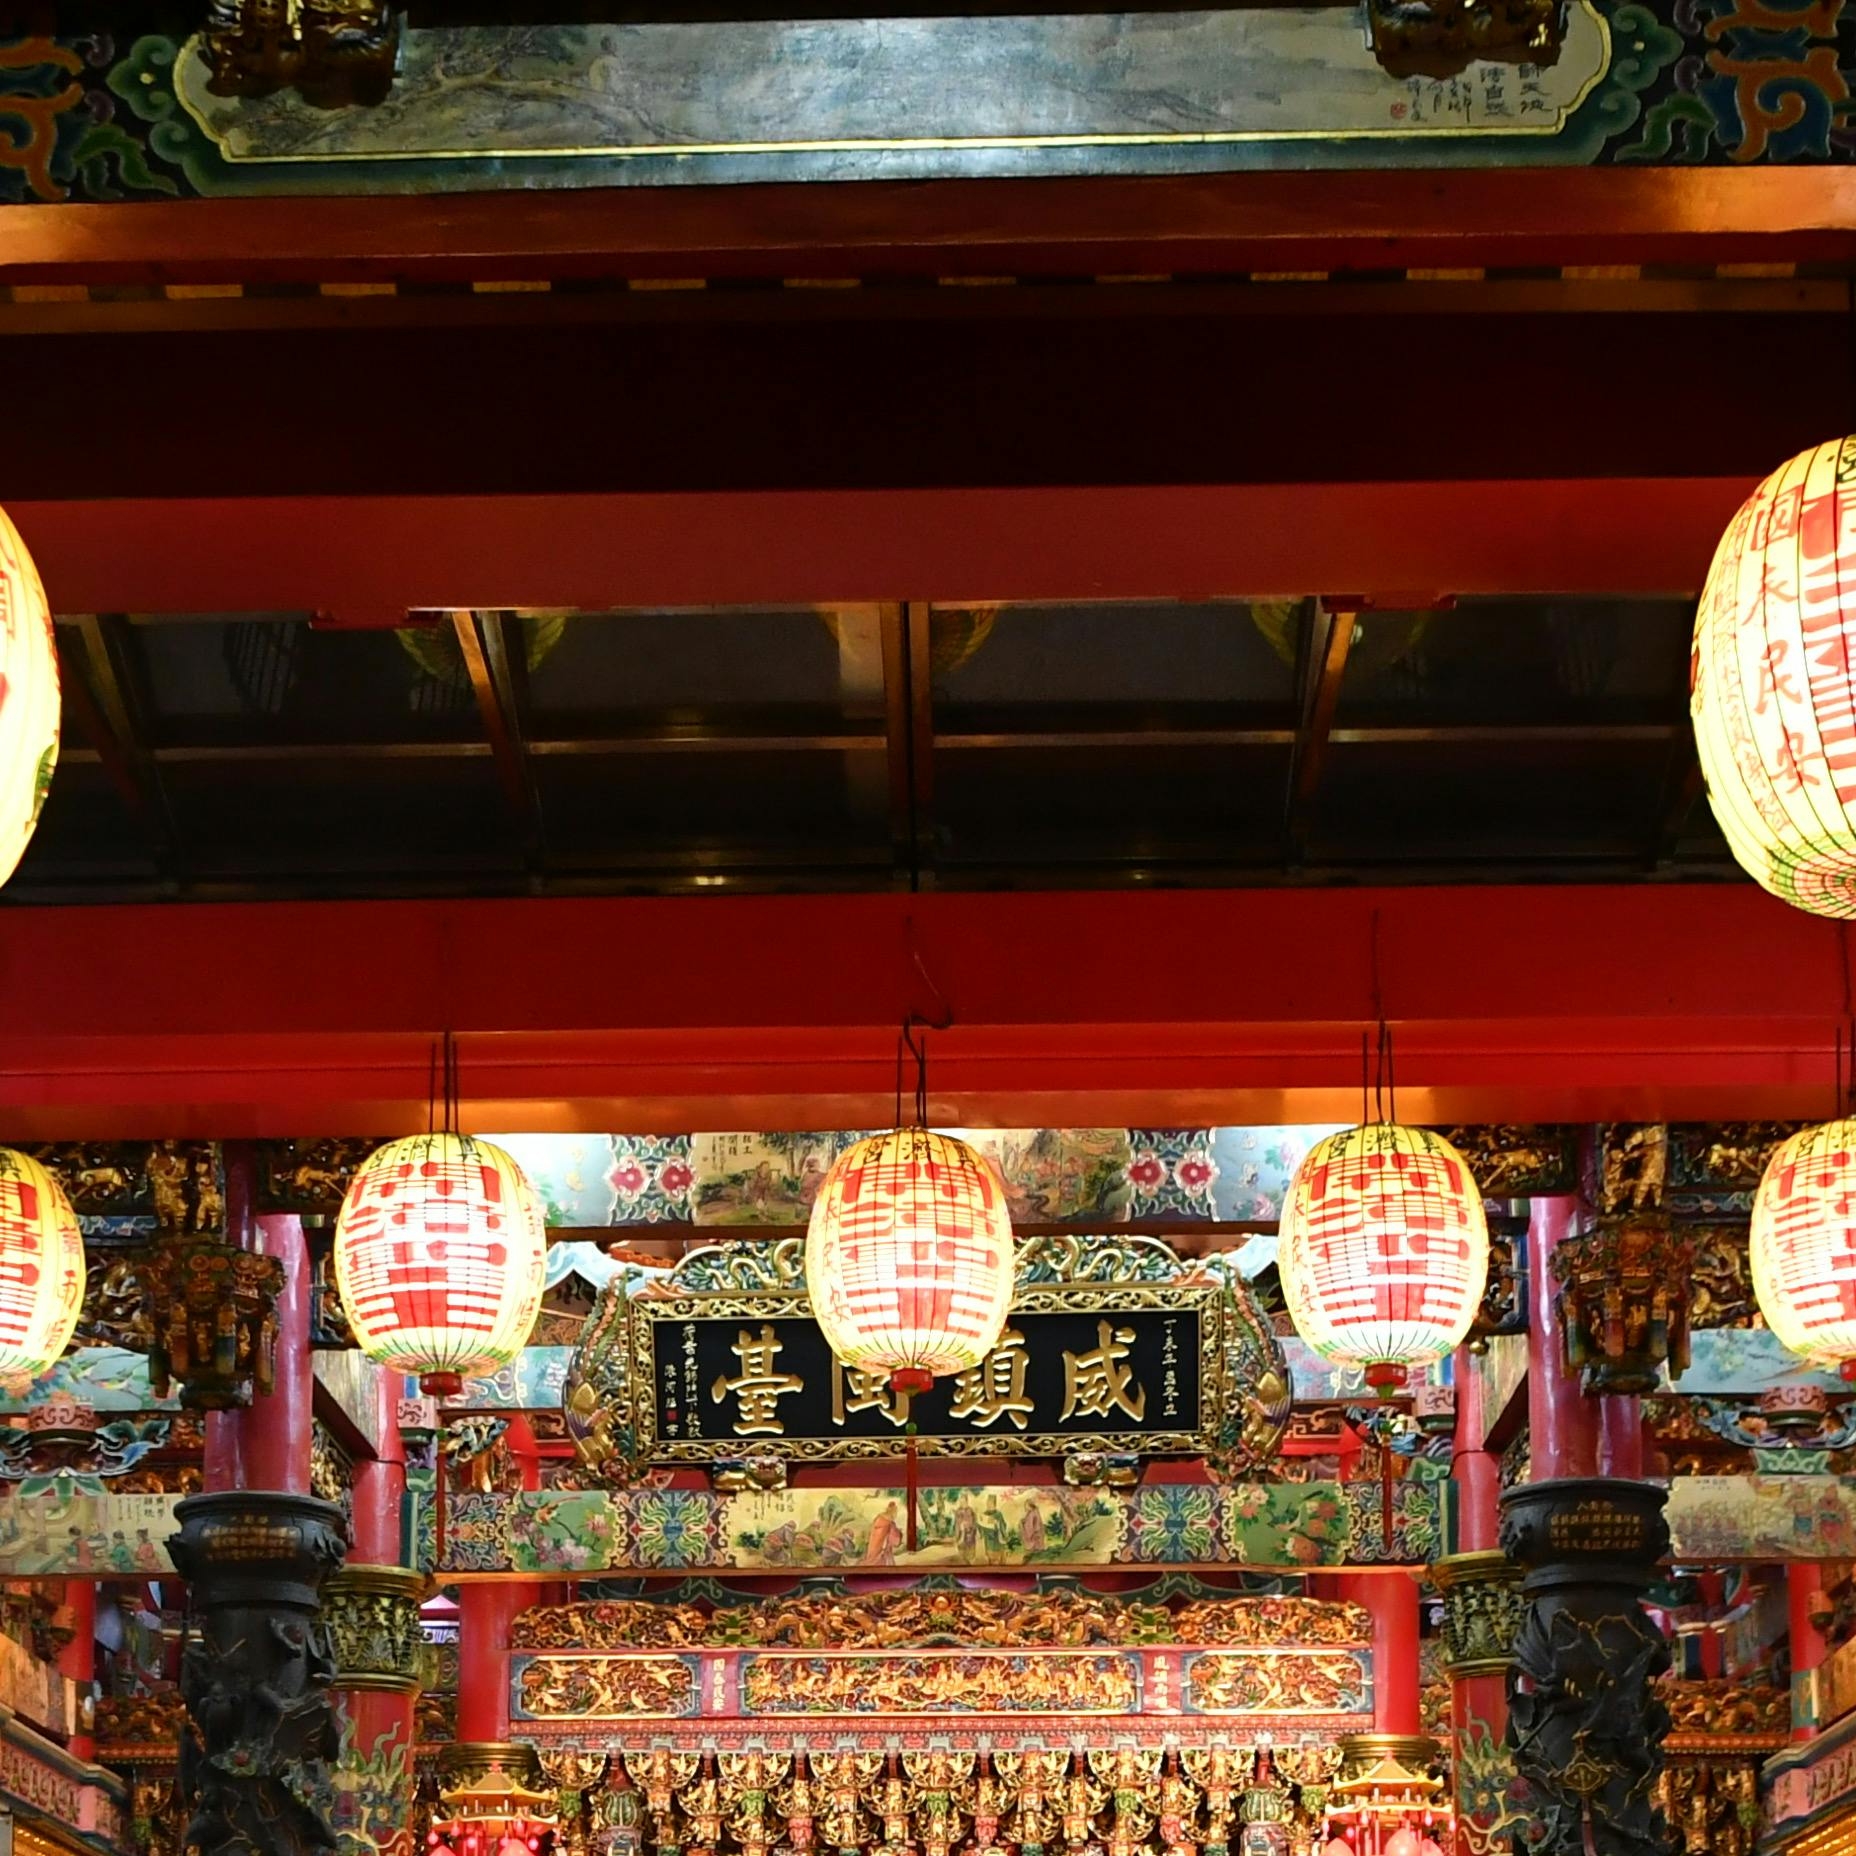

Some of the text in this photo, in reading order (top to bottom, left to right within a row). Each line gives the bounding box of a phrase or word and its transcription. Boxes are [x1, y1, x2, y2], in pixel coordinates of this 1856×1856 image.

[1743, 484, 1822, 803] 國泰民安
[711, 1316, 1146, 1437] 威鎮閩臺
